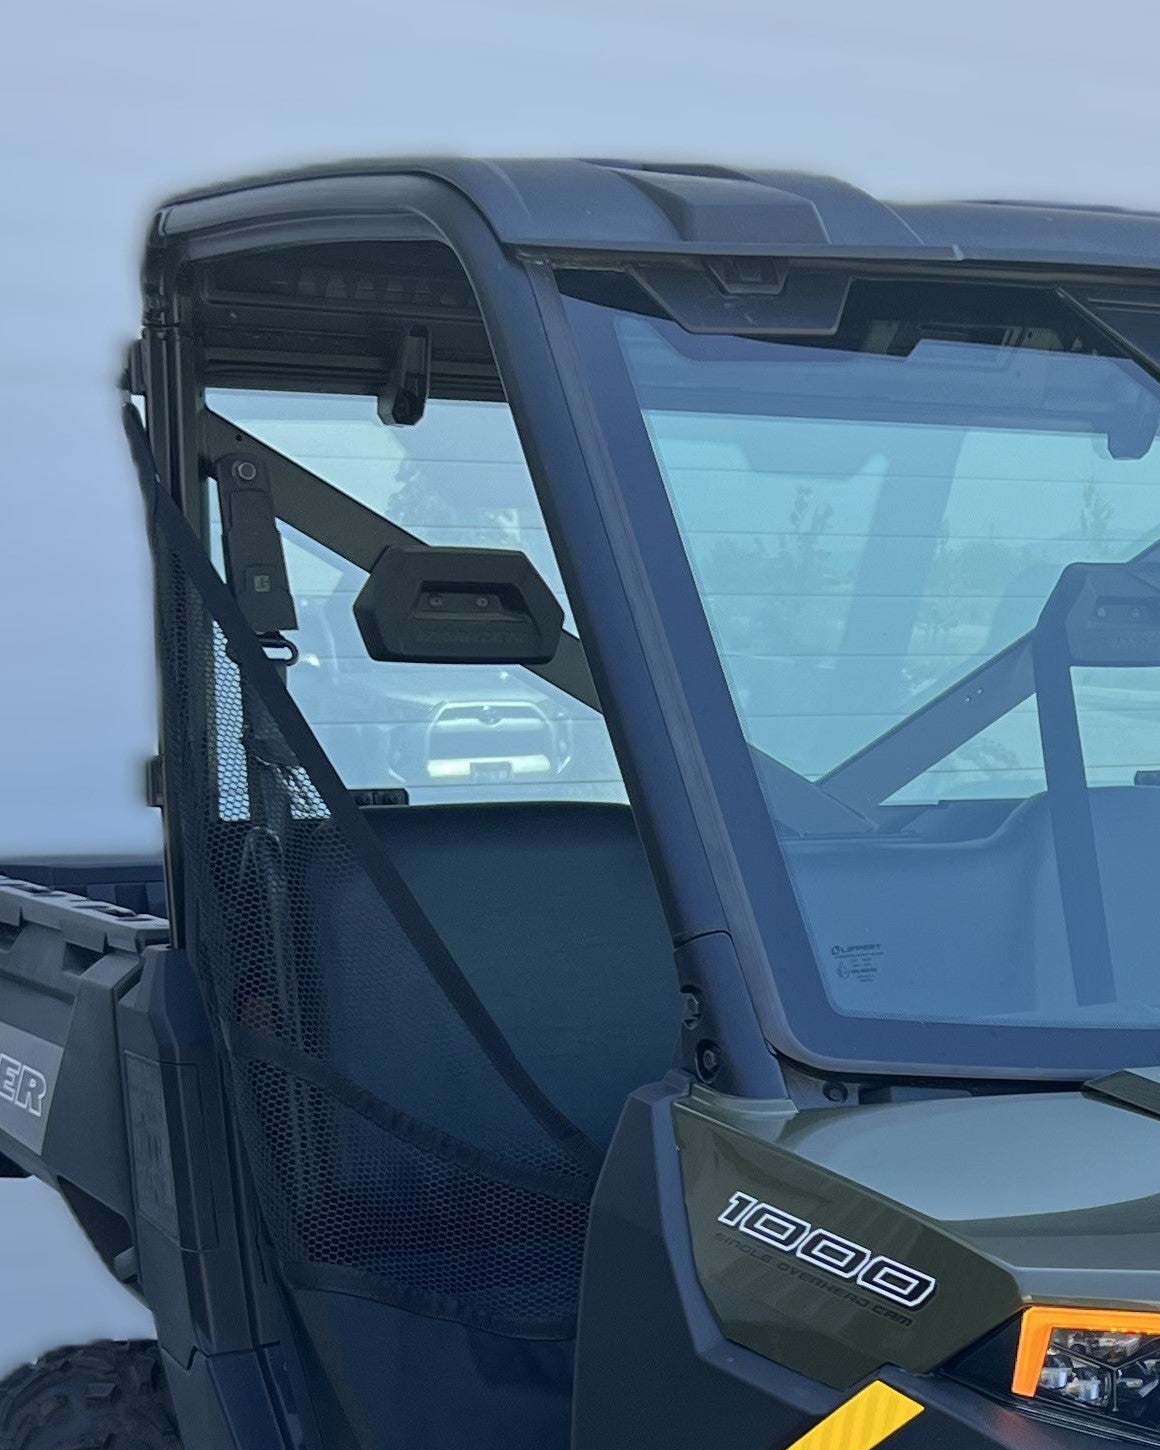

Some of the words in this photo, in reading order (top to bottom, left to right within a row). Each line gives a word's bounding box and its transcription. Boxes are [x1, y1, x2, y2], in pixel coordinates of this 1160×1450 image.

[714, 1232, 772, 1264] SINGLE
[777, 1261, 869, 1308] OVERHEAD
[871, 1303, 914, 1328] CAM
[717, 1190, 938, 1309] 1000
